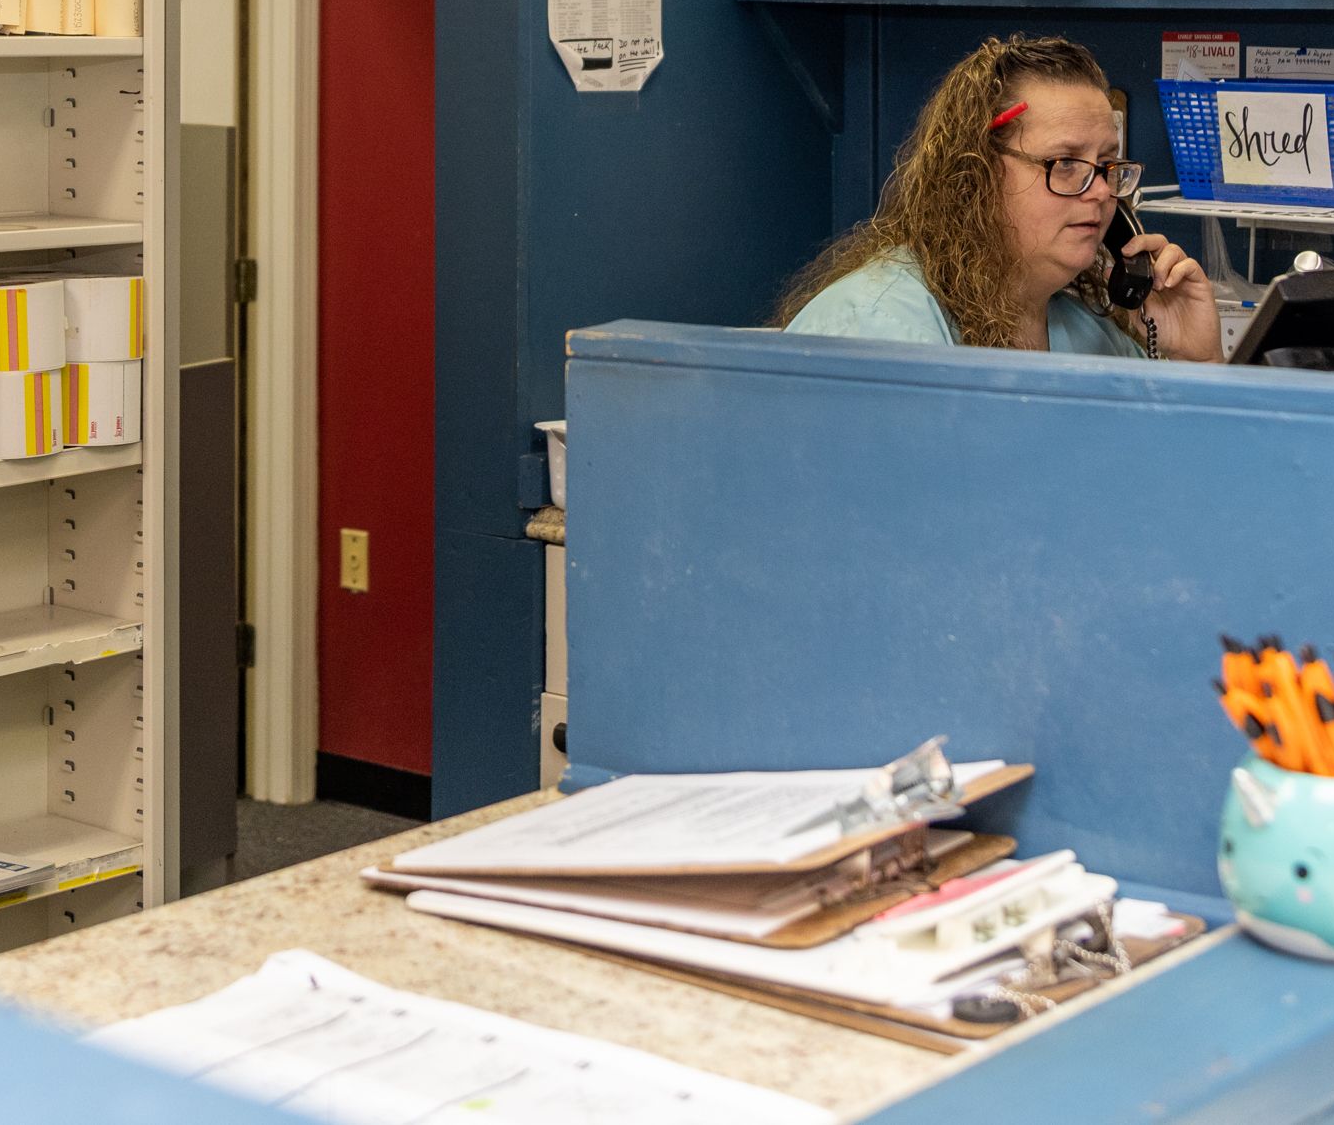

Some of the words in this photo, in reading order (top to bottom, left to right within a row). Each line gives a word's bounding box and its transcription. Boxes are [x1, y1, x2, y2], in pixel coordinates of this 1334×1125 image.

[643, 37, 654, 47] put
[1203, 46, 1235, 57] LIVALO
[1224, 103, 1314, 174] Shred
